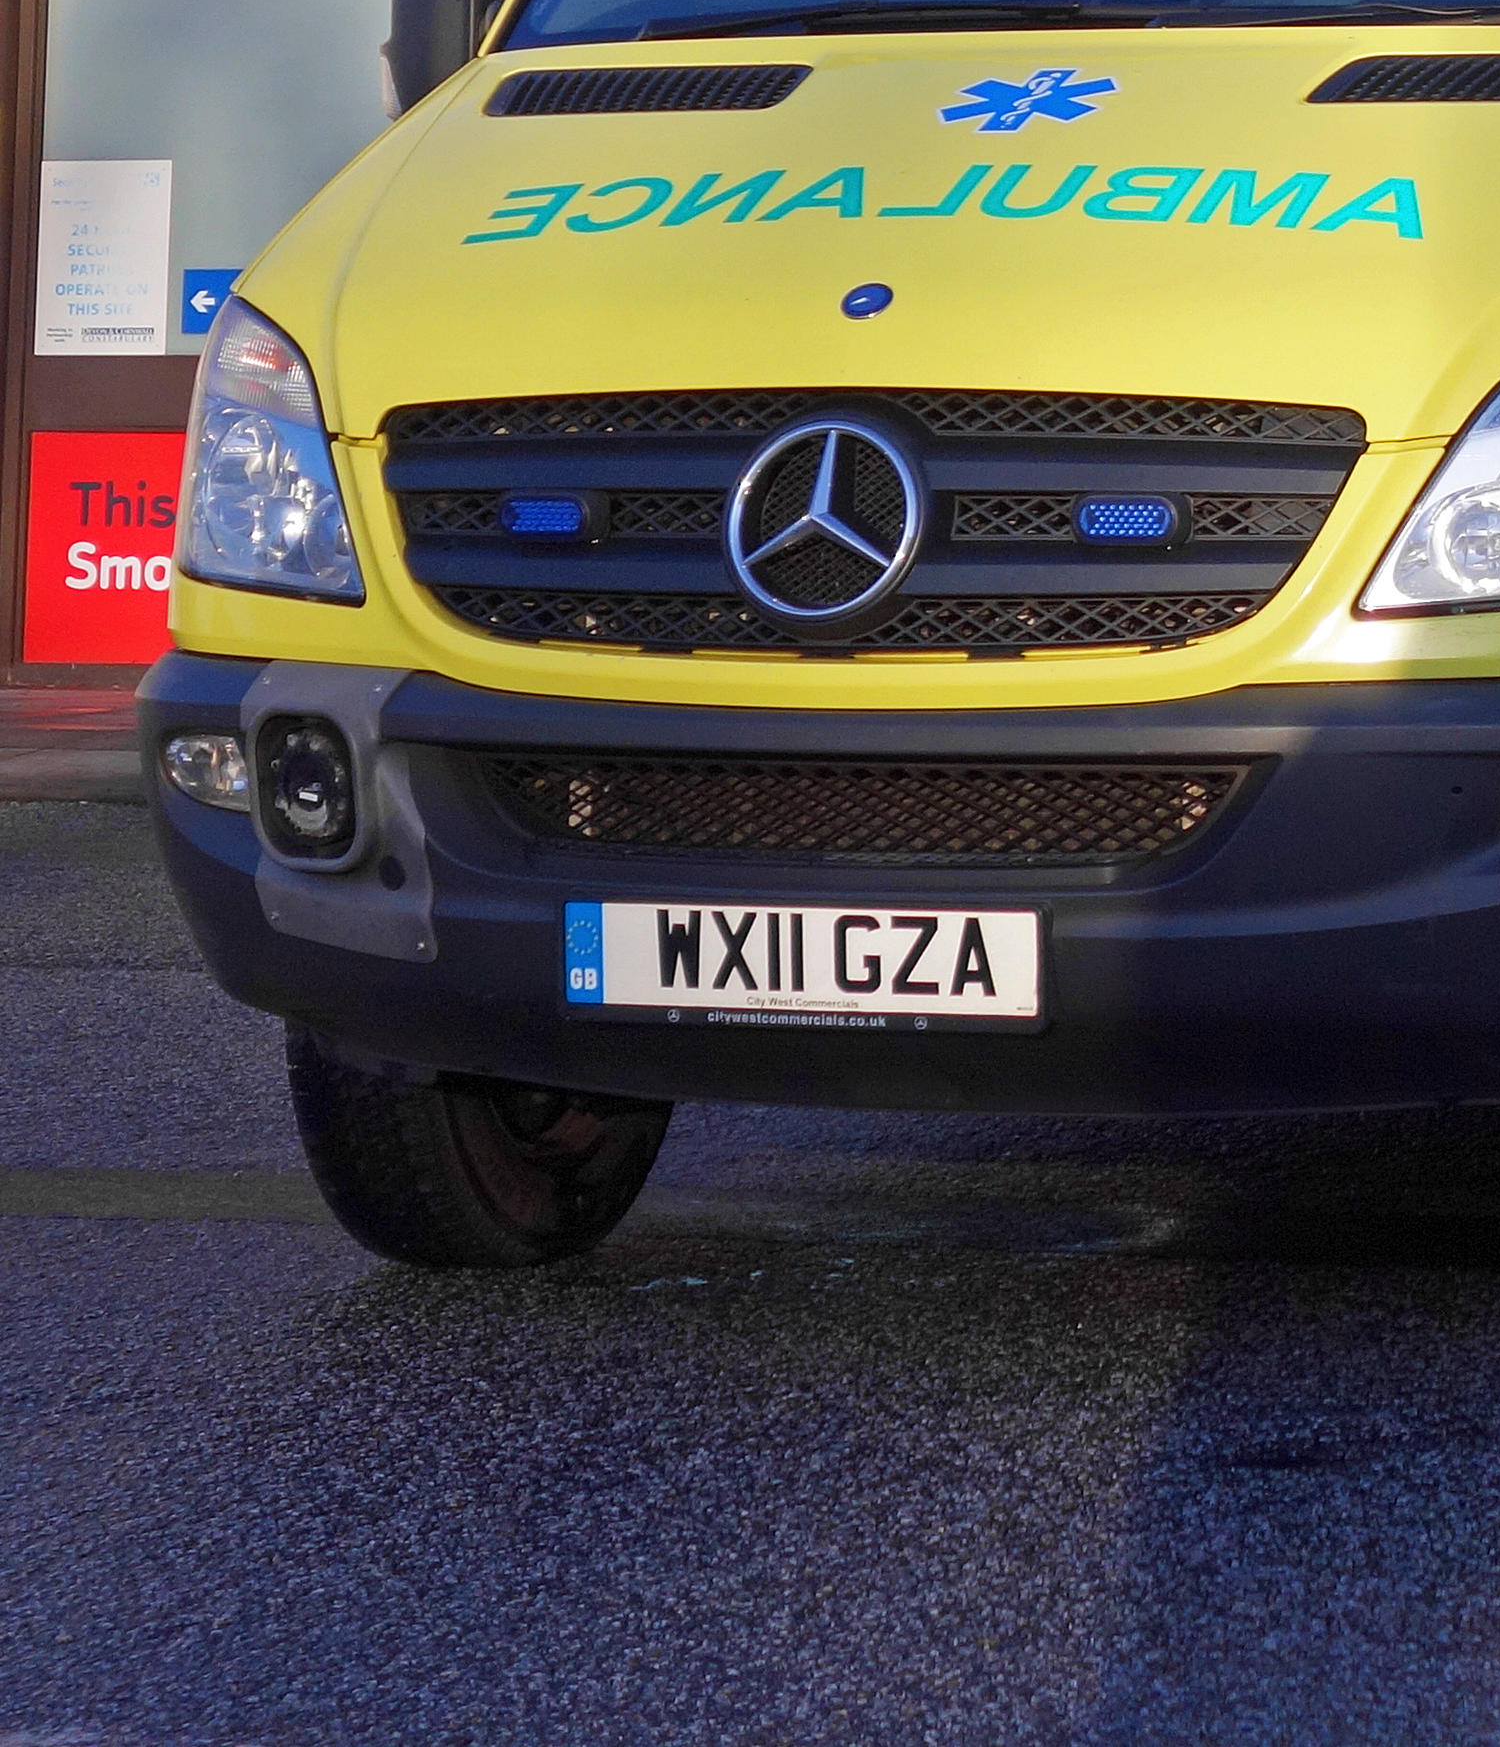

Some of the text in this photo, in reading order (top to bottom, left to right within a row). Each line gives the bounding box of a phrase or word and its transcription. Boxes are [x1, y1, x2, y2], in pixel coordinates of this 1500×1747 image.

[71, 224, 88, 236] 24
[67, 303, 99, 315] THIS
[70, 480, 176, 528] This
[65, 541, 171, 591] Smo
[657, 909, 997, 997] WX11 GZA
[570, 967, 598, 990] GB
[747, 996, 859, 1008] City West Commercials
[707, 1011, 886, 1027] citywestcommercials.co.uk
